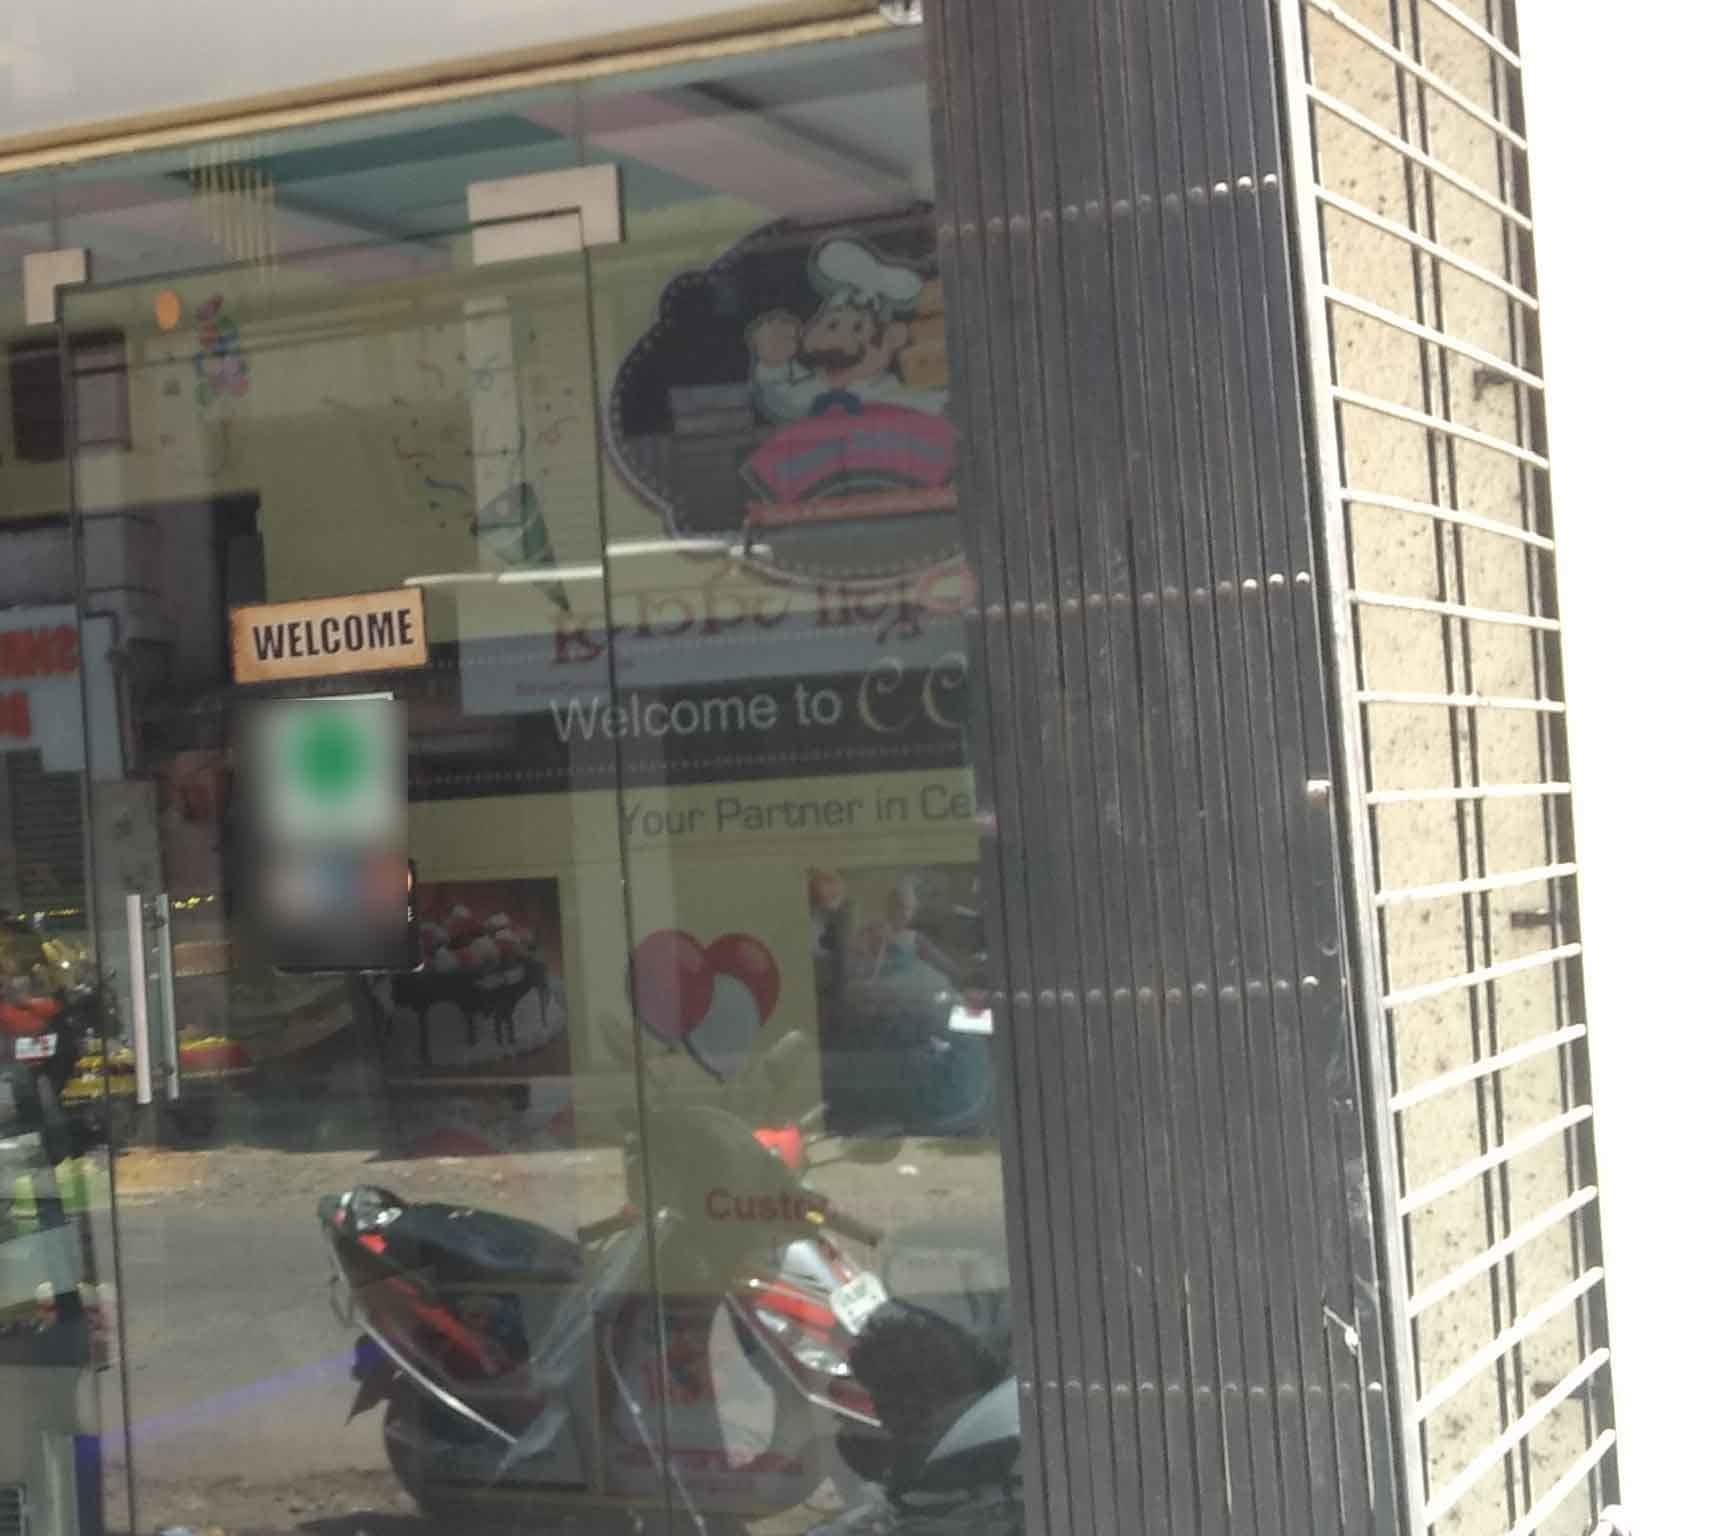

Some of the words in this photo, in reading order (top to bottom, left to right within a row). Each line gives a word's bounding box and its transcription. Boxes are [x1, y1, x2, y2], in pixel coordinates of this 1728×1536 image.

[253, 608, 414, 661] WELCOME
[550, 691, 777, 743] Welcome
[795, 682, 842, 726] to
[715, 790, 864, 832] Partner
[876, 786, 906, 822] in
[919, 783, 972, 822] Ce
